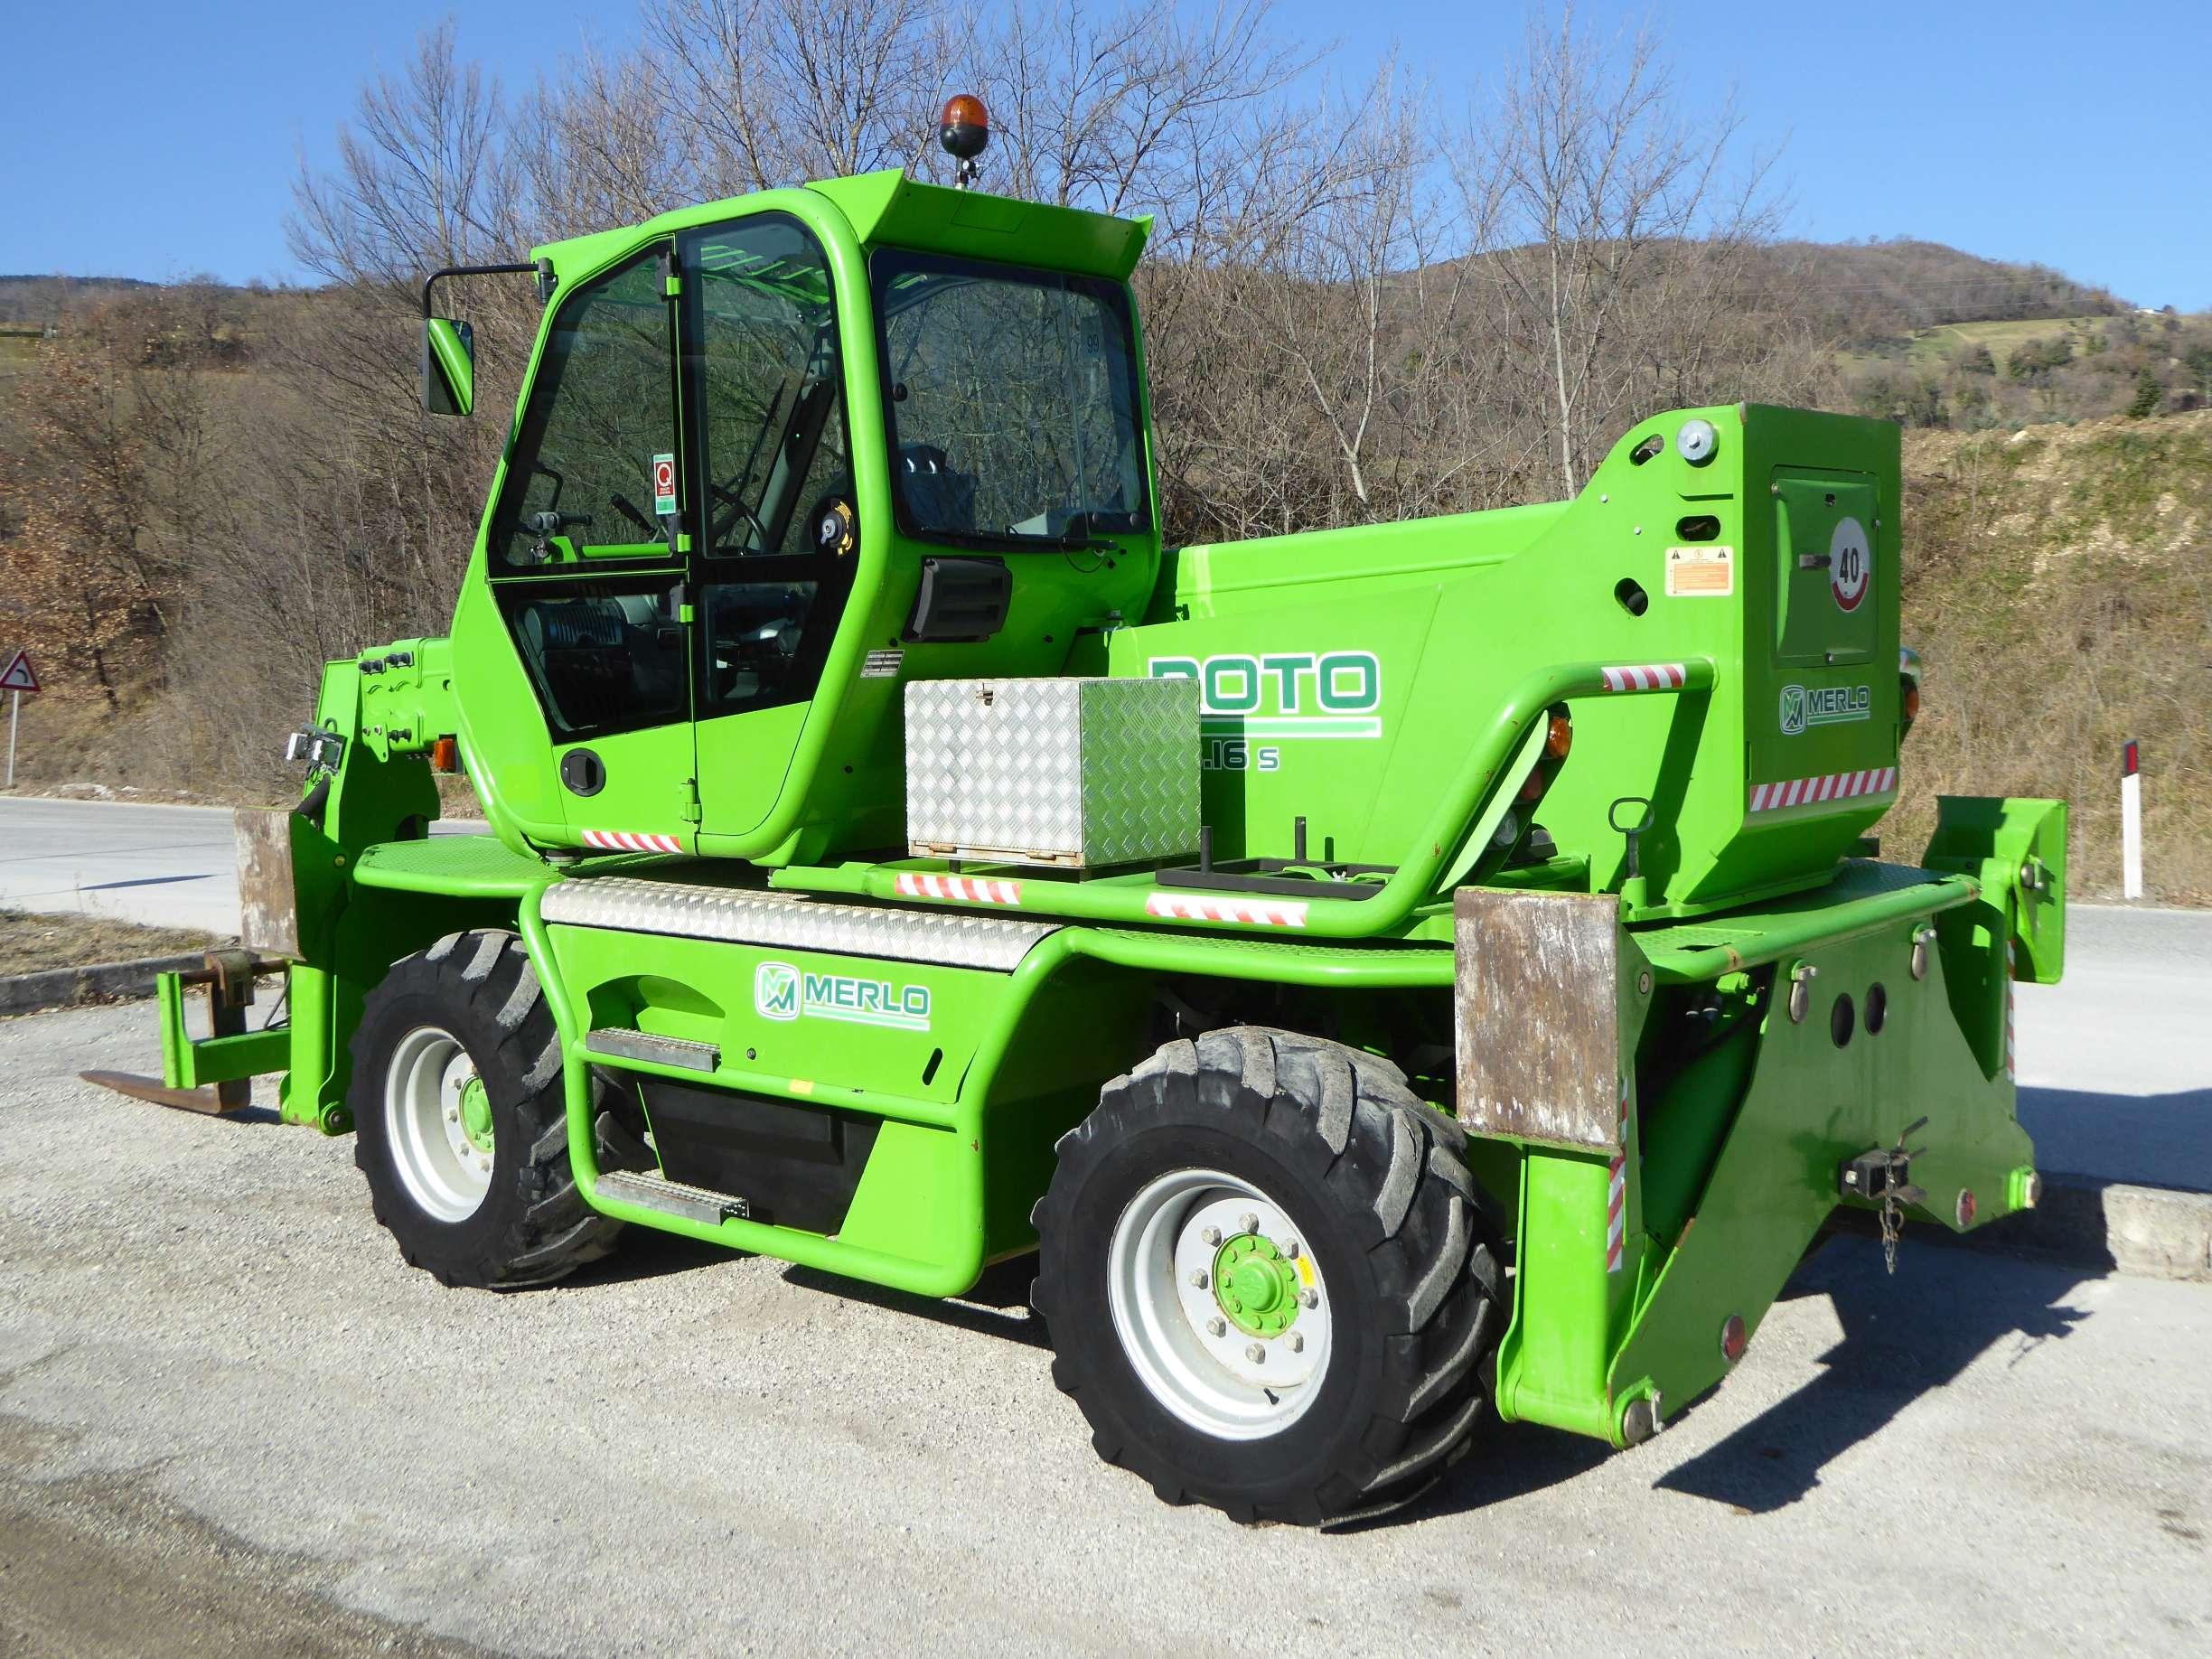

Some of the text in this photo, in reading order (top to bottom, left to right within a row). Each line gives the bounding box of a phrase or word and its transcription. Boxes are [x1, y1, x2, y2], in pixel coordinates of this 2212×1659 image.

[1839, 547, 1860, 584] 40
[1148, 651, 1381, 715] OTO
[1807, 686, 1870, 715] MERLO
[803, 972, 930, 1017] MERLO
